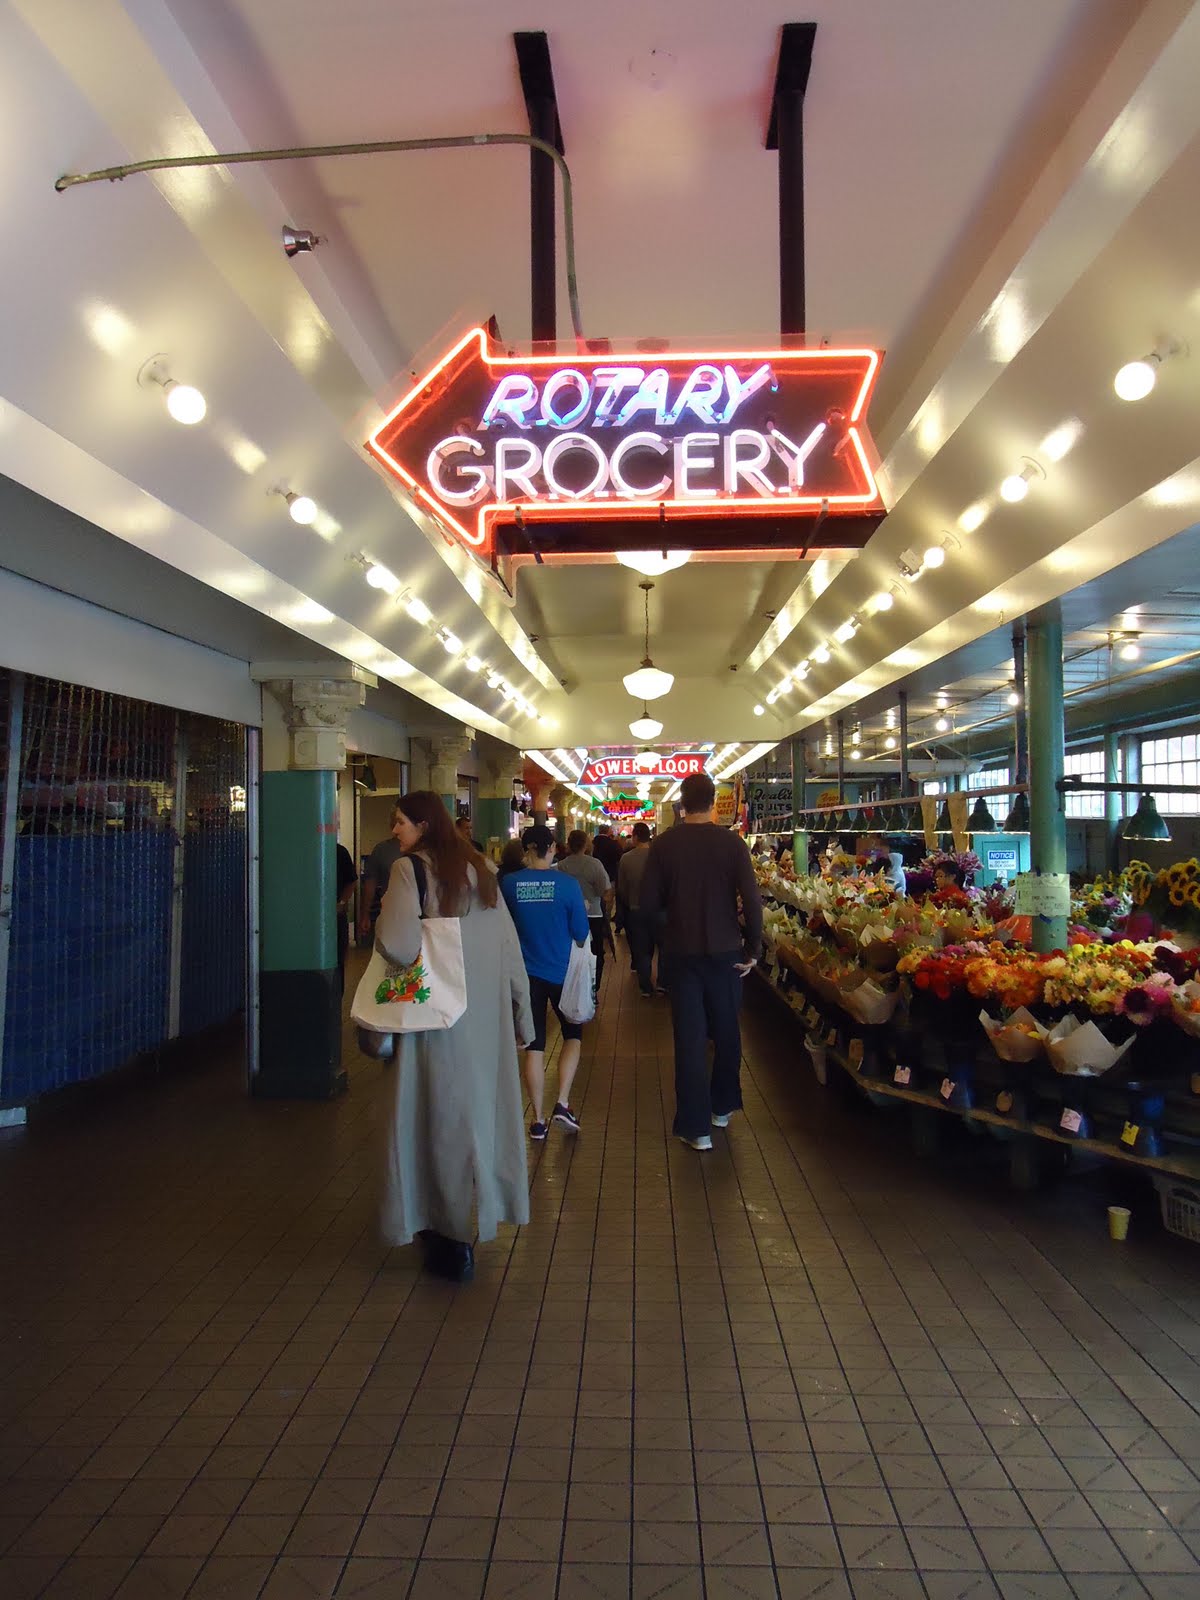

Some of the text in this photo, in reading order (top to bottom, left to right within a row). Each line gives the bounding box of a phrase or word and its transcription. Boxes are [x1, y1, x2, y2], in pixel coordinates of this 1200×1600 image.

[476, 362, 778, 431] ROTARY
[426, 430, 827, 507] GROCERY
[586, 759, 641, 782] LOWER
[754, 788, 793, 802] Qualit
